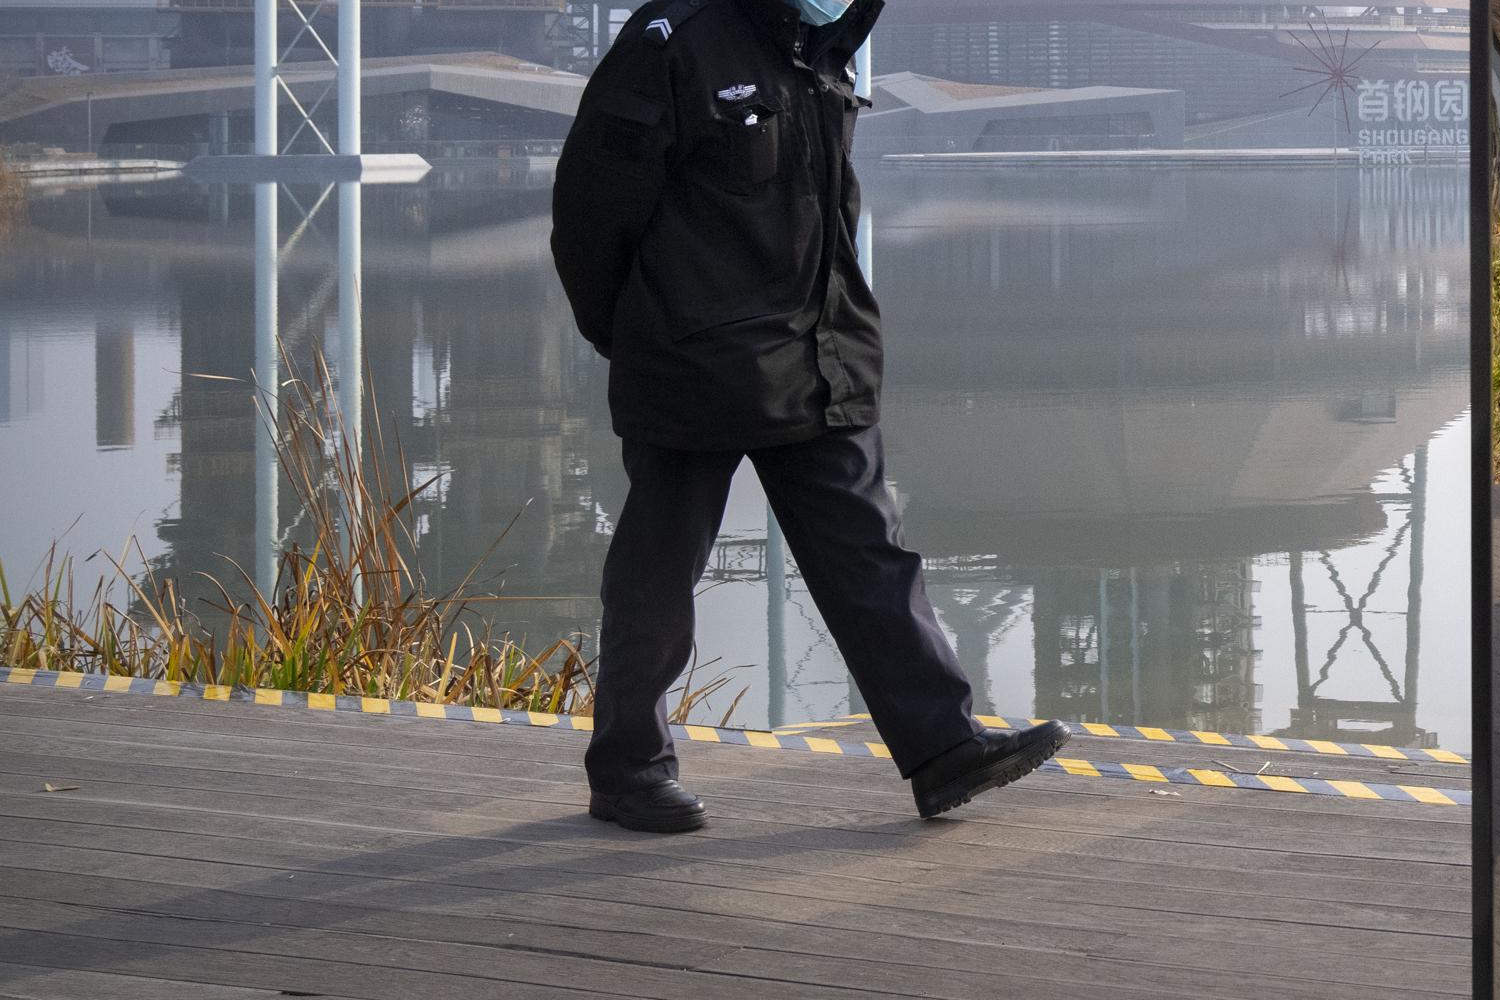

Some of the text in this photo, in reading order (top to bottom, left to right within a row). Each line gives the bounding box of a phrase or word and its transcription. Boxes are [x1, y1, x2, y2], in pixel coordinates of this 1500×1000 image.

[1357, 79, 1468, 122] 首钢园
[1358, 129, 1468, 145] SHOUGANG
[1359, 149, 1413, 164] PARK
